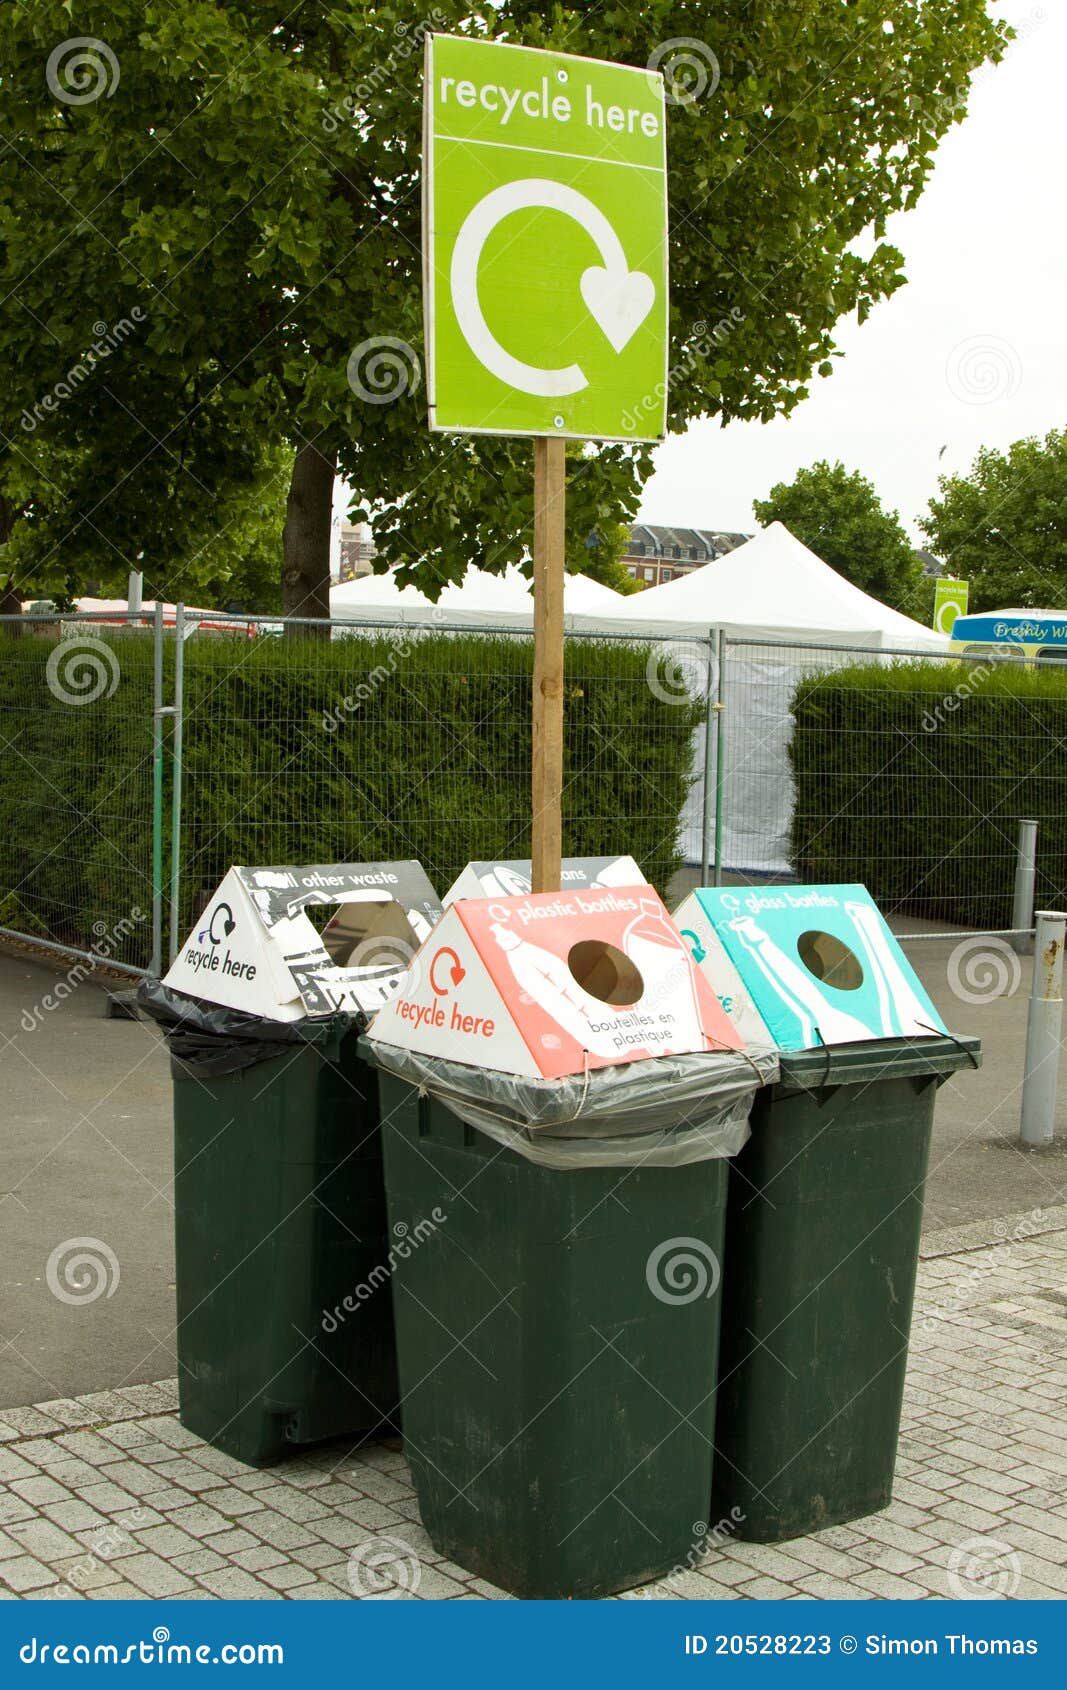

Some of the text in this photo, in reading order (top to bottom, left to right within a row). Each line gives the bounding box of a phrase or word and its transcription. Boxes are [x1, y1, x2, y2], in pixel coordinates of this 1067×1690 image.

[440, 76, 659, 137] recycle here
[996, 623, 1048, 641] Freshly
[302, 871, 345, 888] other
[348, 872, 399, 887] waste
[560, 869, 586, 881] ans
[516, 894, 638, 925] plastic bottles
[745, 891, 839, 914] glass bottles
[184, 945, 257, 981] recycle here
[395, 998, 496, 1038] recycle here
[587, 1012, 676, 1033] bouteilles en
[613, 1029, 673, 1050] plastique
